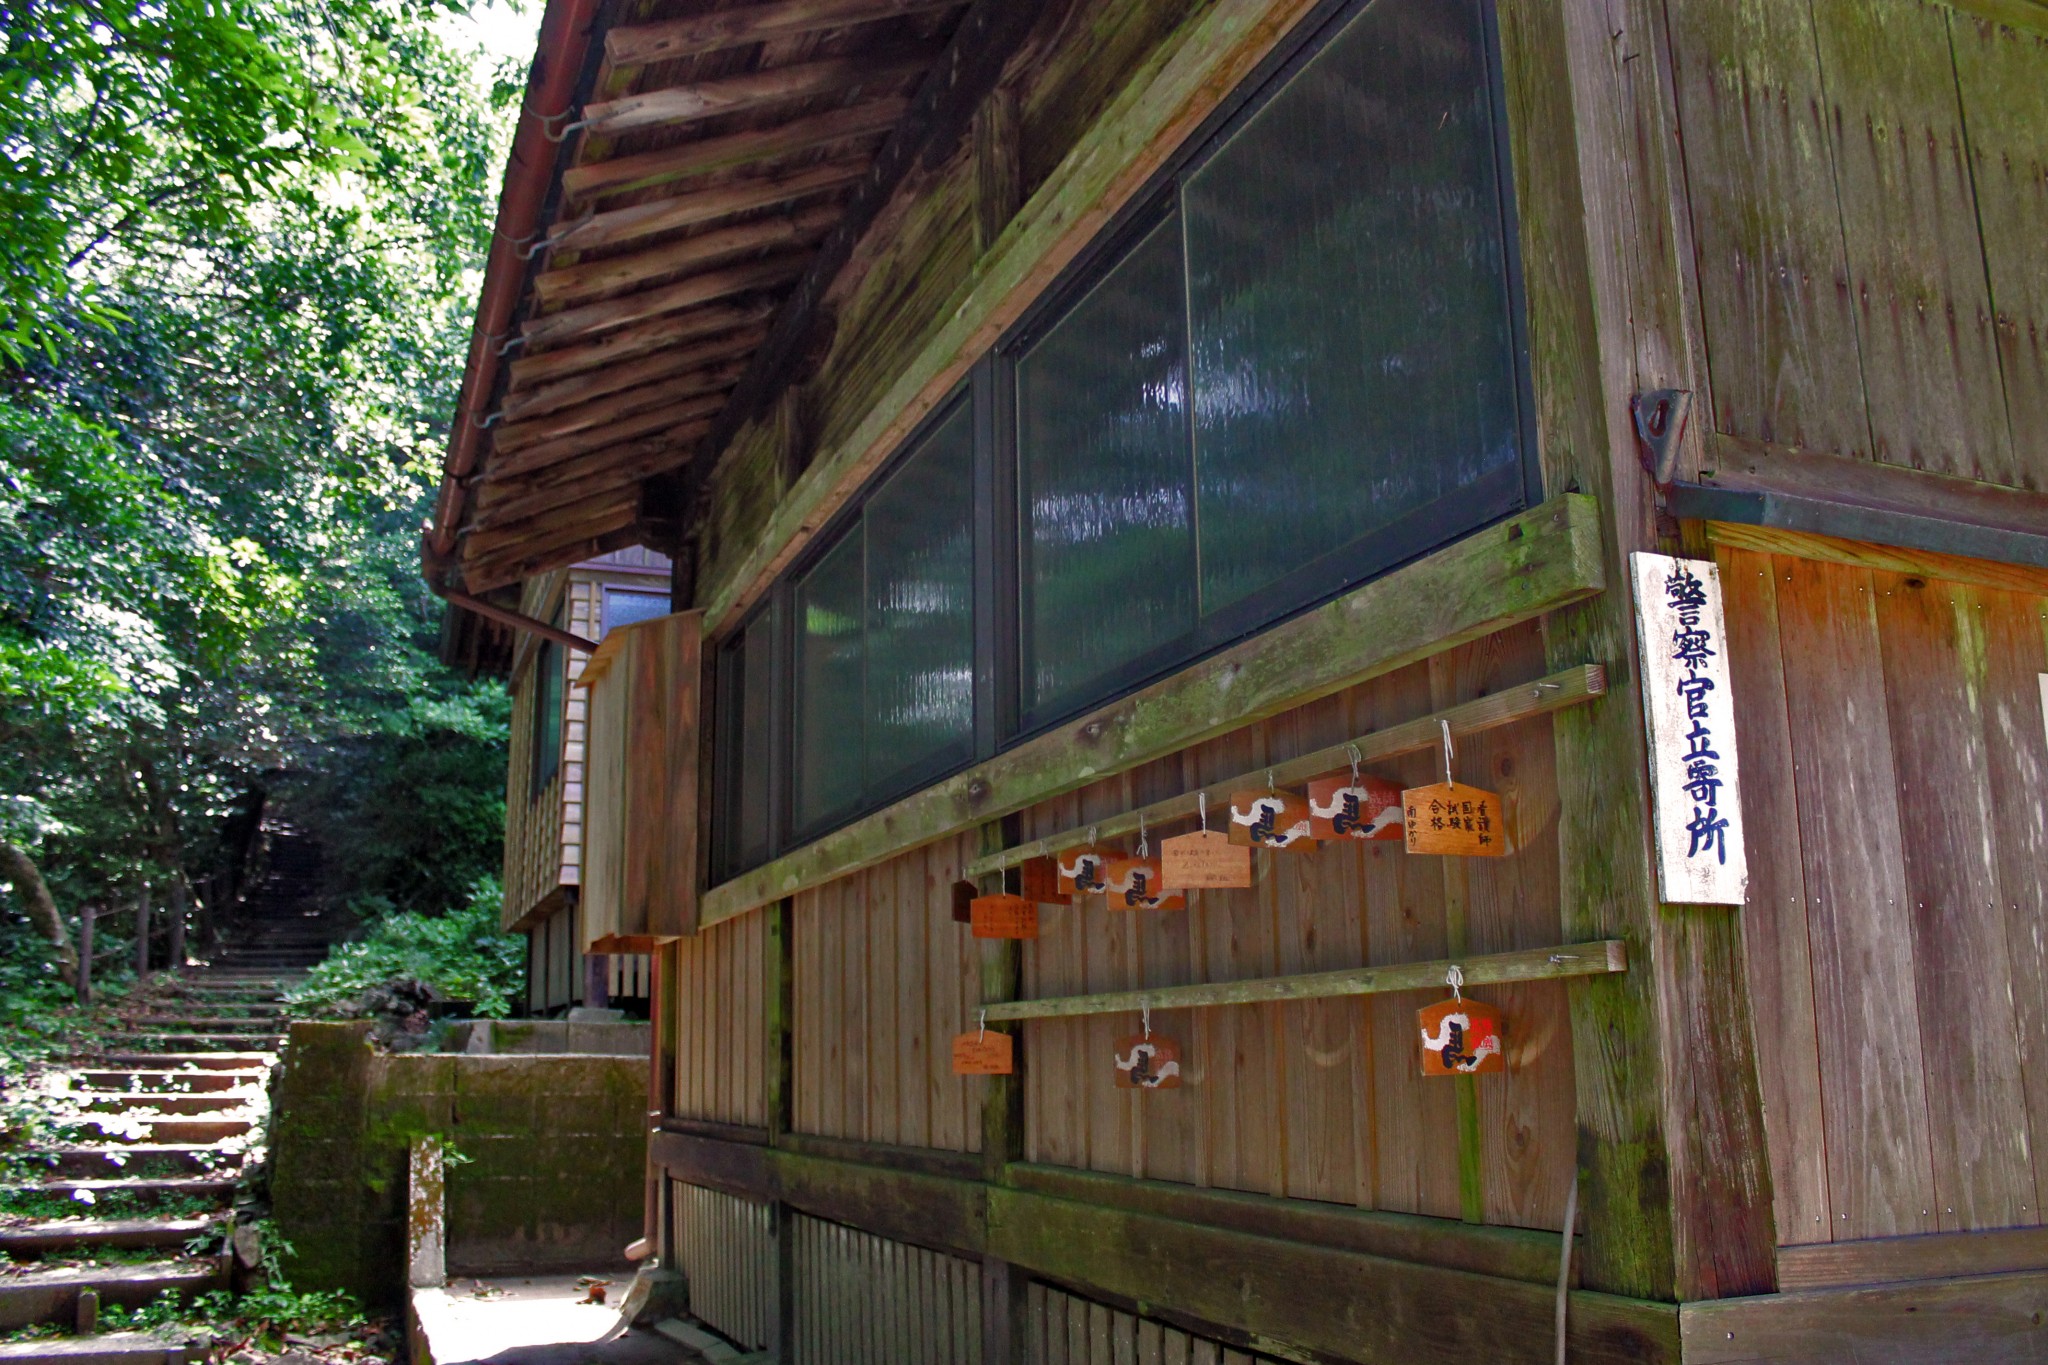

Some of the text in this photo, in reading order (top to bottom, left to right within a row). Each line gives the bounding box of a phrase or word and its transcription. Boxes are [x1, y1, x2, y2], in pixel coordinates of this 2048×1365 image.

[1665, 570, 1729, 865] 警察官立寄所
[1429, 799, 1446, 831] 合格
[1447, 800, 1462, 830] 試験
[1461, 801, 1475, 832] 国家
[1477, 800, 1492, 847] 看護師
